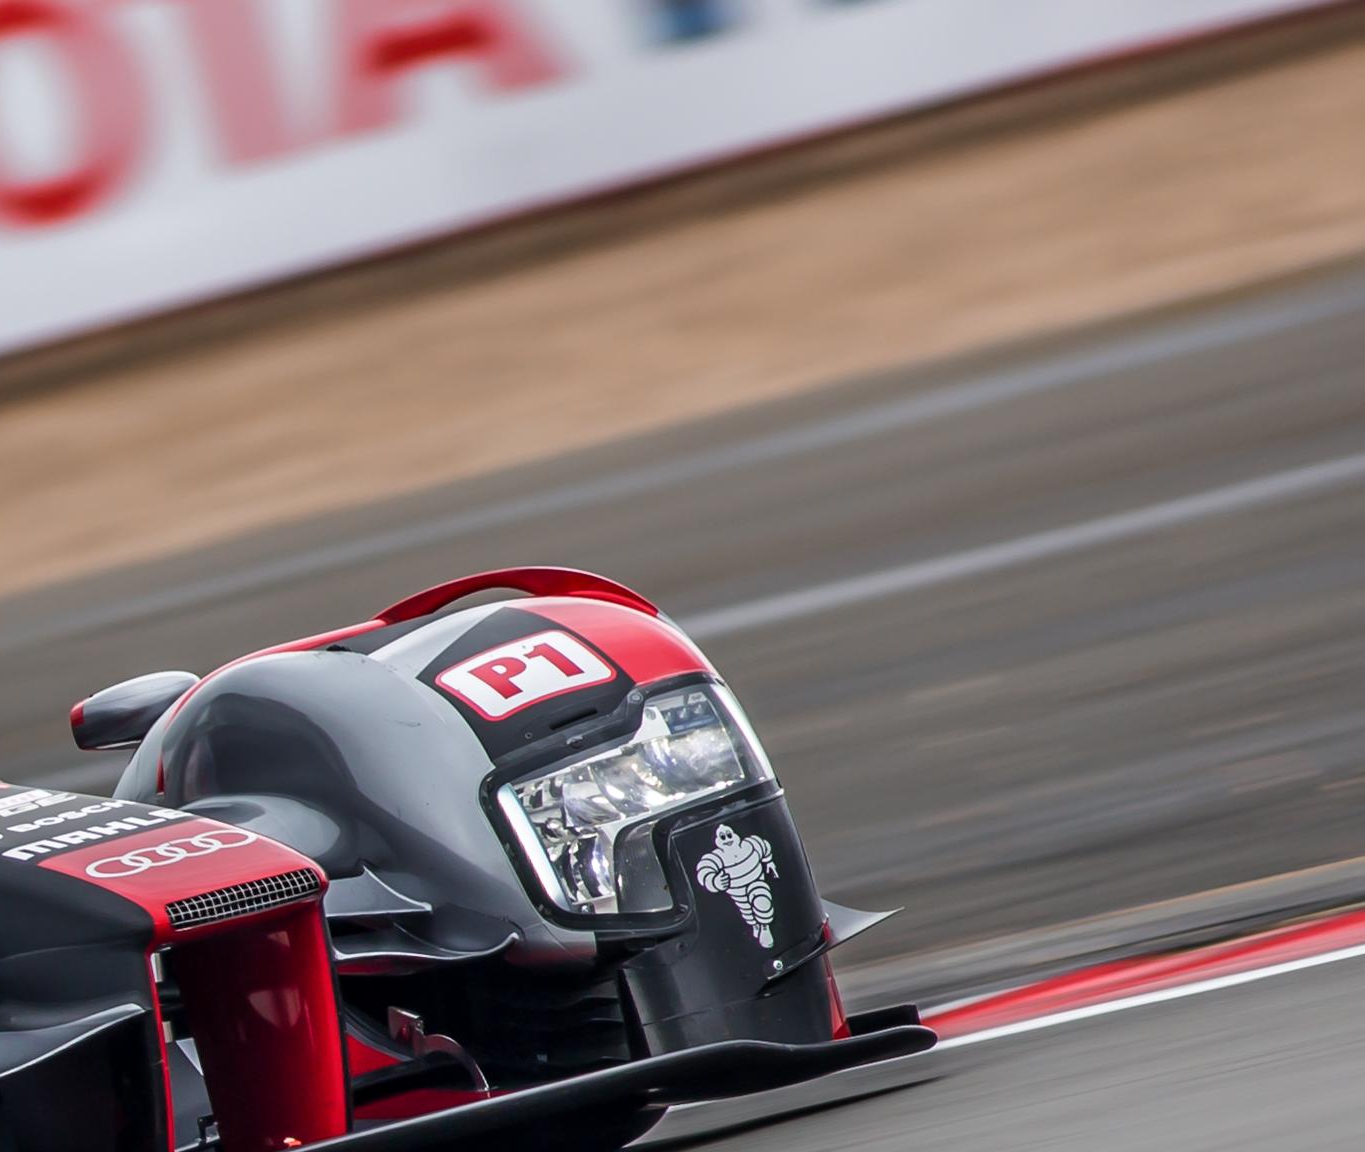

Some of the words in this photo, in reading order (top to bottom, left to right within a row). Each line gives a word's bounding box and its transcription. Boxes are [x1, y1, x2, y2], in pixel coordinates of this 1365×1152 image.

[467, 643, 585, 700] P1
[1, 808, 194, 861] MAHLE
[6, 800, 137, 833] BOSCH
